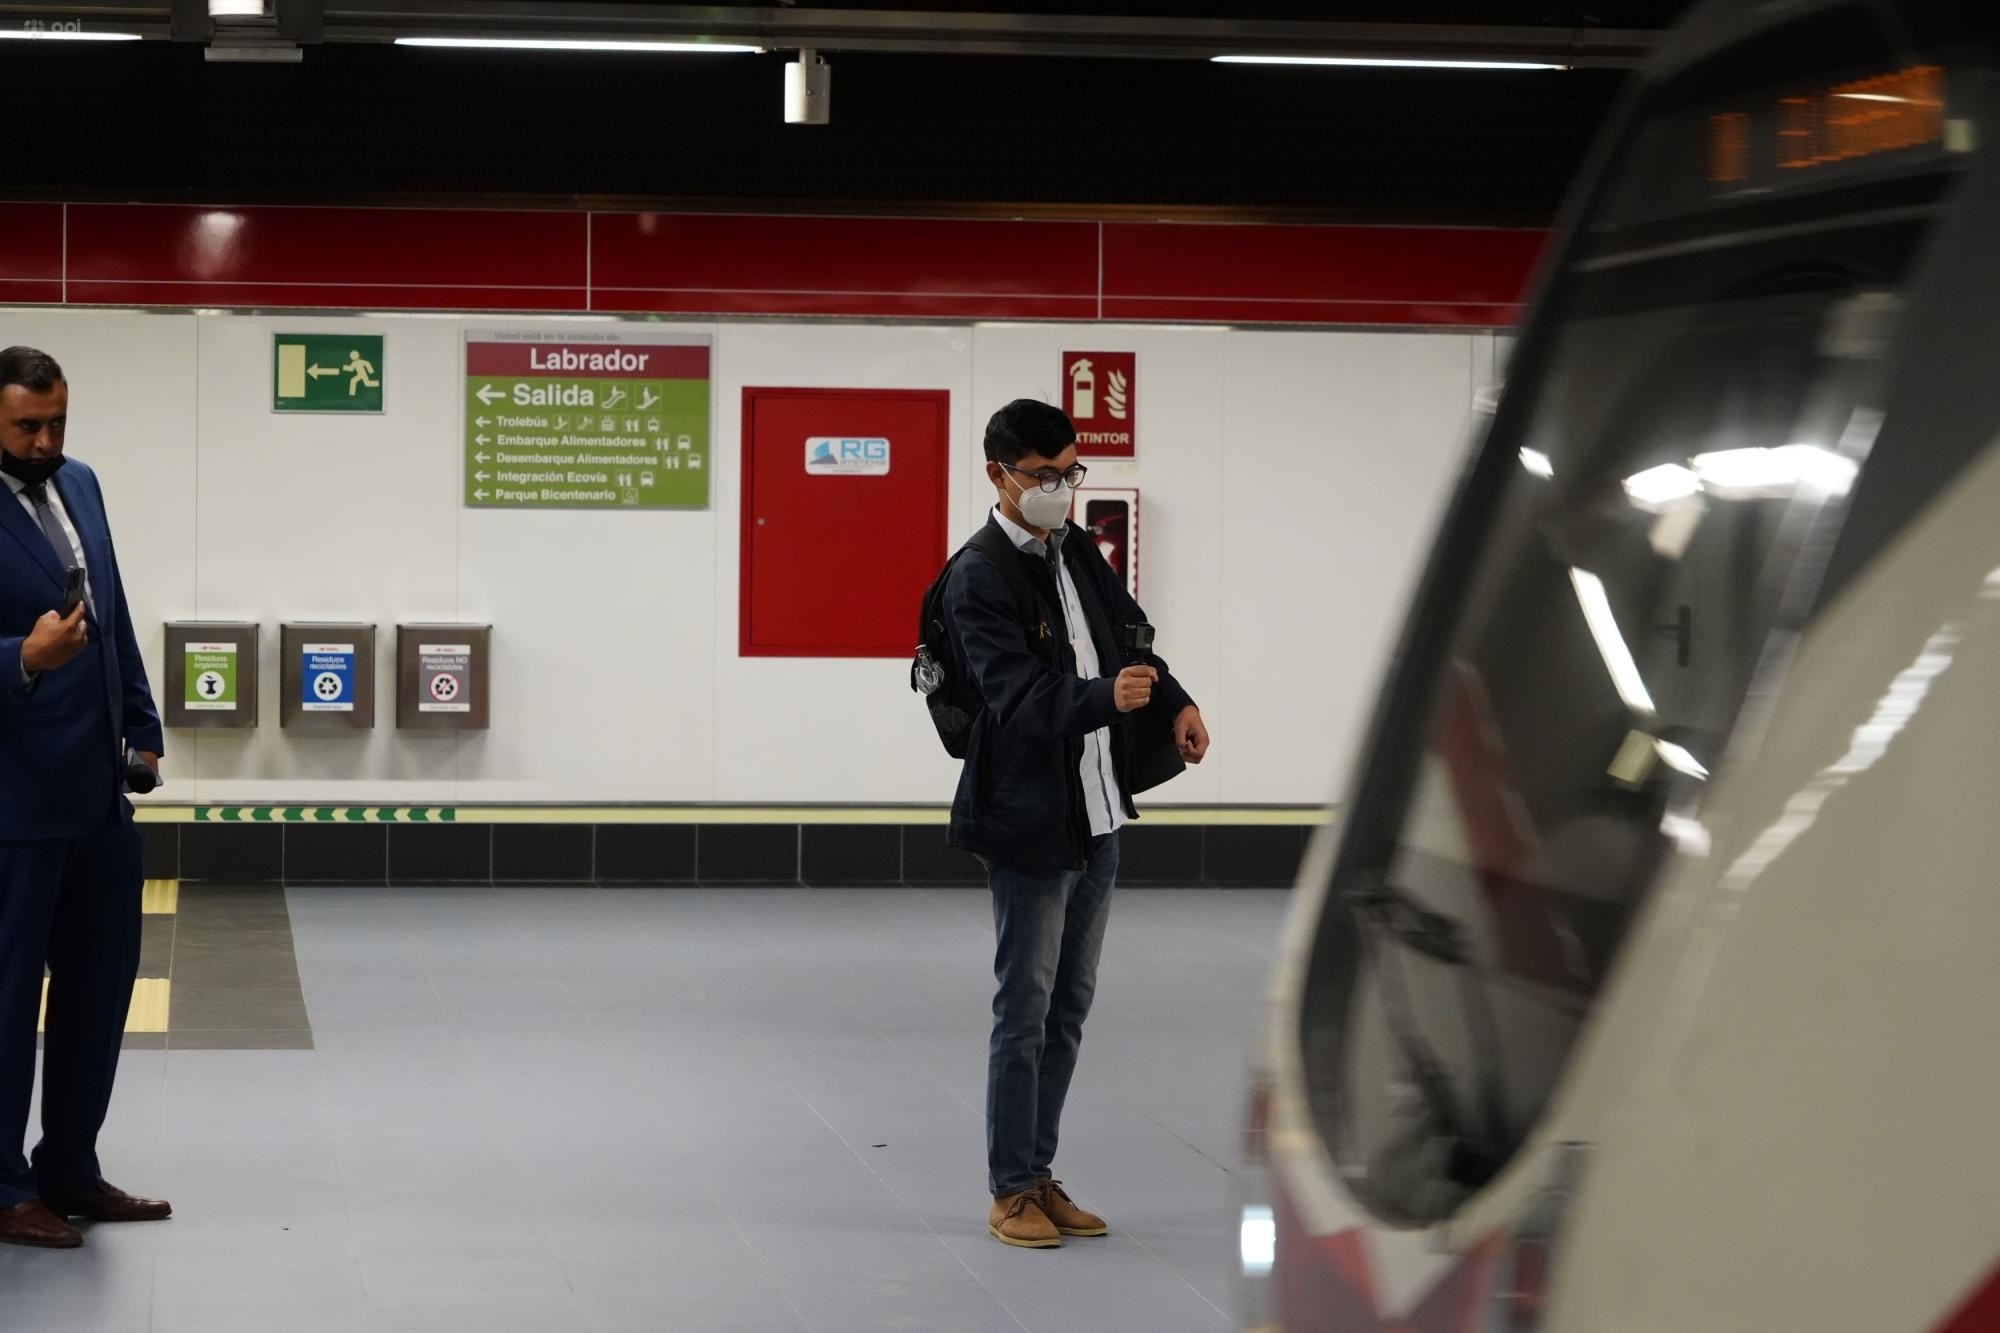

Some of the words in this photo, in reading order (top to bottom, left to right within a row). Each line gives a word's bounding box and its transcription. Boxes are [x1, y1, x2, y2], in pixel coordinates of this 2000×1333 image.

[530, 348, 649, 371] Labrador
[512, 383, 594, 406] Salida
[496, 415, 548, 428] Trolebús
[497, 435, 558, 448] Embarque
[560, 435, 646, 447] Alimentadores
[1075, 432, 1129, 444] XTINTOR
[841, 440, 886, 459] RG
[496, 453, 575, 466] Desembarque
[577, 454, 658, 465] Alimentadores
[497, 471, 564, 484] Integración
[495, 489, 538, 501] Parque
[541, 489, 616, 501] Bicentenario
[311, 655, 345, 663] Residuos
[455, 656, 468, 664] NO
